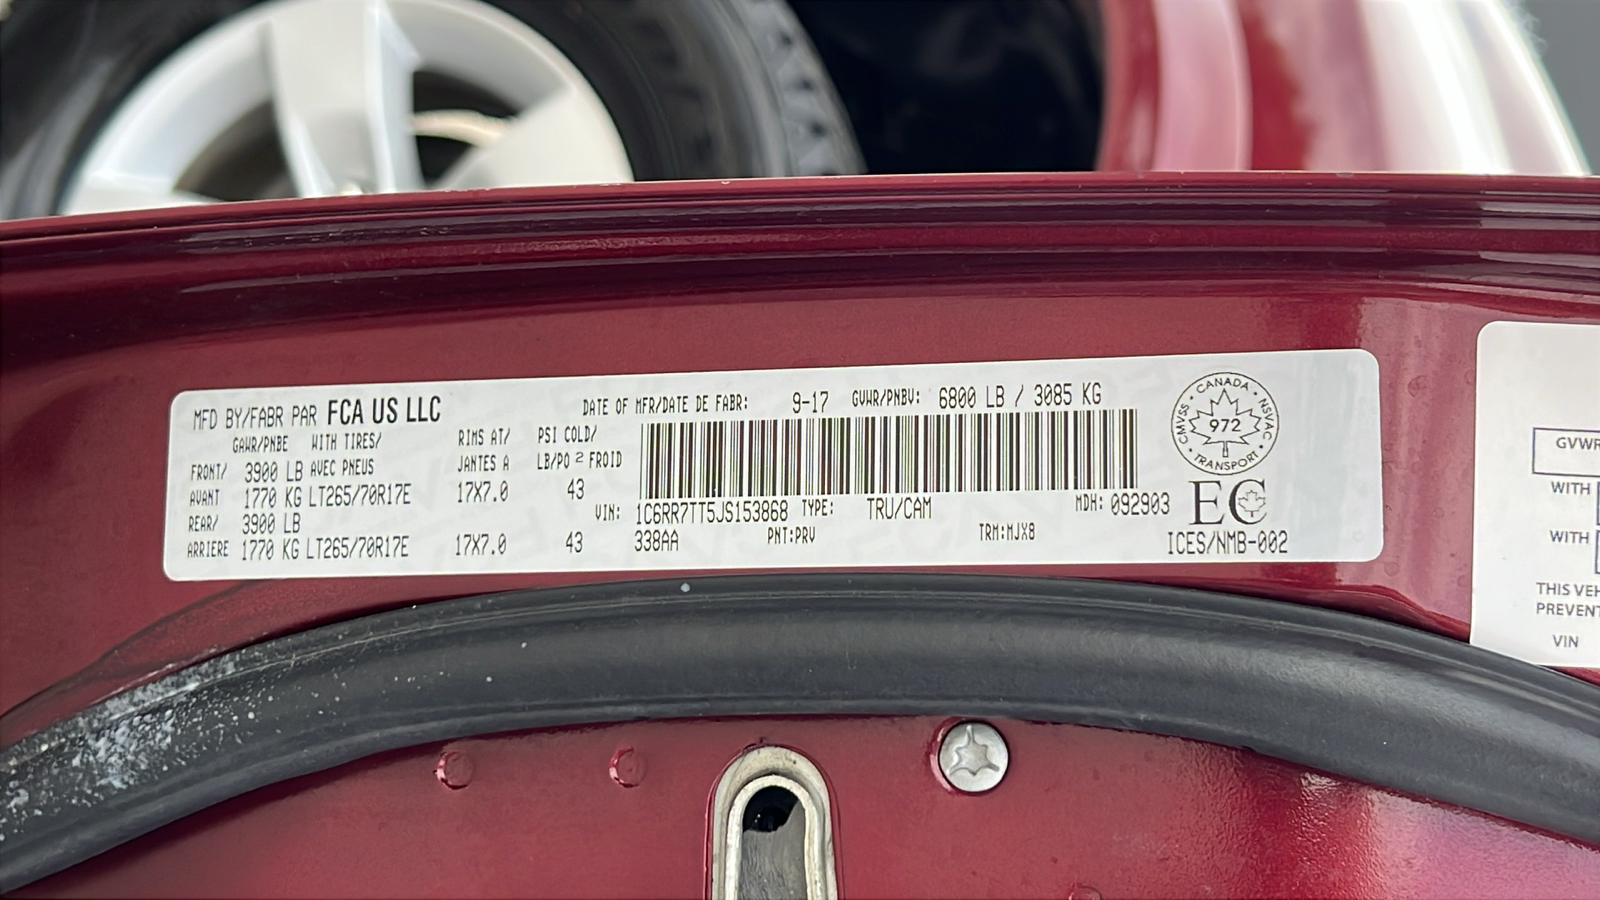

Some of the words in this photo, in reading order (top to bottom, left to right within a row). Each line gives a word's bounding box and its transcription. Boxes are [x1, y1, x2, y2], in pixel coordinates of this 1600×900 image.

[1196, 378, 1248, 394] CANADA
[583, 399, 608, 415] DATE
[616, 398, 628, 414] OF
[635, 396, 688, 414] MFR/DATE
[696, 395, 709, 412] DE
[716, 395, 748, 411] FABR:
[792, 391, 828, 414] 9-17
[852, 388, 920, 407] GVWR/PNBV:
[939, 387, 976, 409] 6800
[986, 385, 1005, 408] LB
[1034, 384, 1072, 406] 3085
[1082, 383, 1101, 405] KG
[194, 409, 218, 430] MFD
[225, 407, 284, 429] BY/FABR
[291, 405, 317, 426] PAR
[327, 400, 363, 425] FCA
[372, 398, 398, 424] US
[407, 396, 441, 422] LLC
[1257, 397, 1274, 441] NSVAC
[1176, 403, 1189, 445] CMVSS
[1209, 419, 1241, 432] 972
[232, 435, 288, 453] GAWR/PNBE
[312, 433, 336, 451] WITH
[345, 432, 382, 449] TIRES/
[458, 429, 484, 446] RIMS
[491, 428, 510, 445] AT/
[538, 426, 557, 444] PSI
[564, 425, 597, 443] COLD/
[1556, 437, 1600, 450] GVWR
[310, 460, 336, 476] AVEC
[342, 459, 374, 475] PNEUS
[458, 455, 496, 472] JANTES
[503, 455, 510, 471] A
[537, 452, 570, 470] LB/PO
[589, 451, 622, 469] FROID
[1193, 450, 1259, 470] TRANSPORT
[191, 463, 227, 481] FRONT/
[244, 462, 277, 483] 3900
[286, 460, 303, 482] LB
[190, 489, 219, 506] AVANT
[244, 487, 276, 509] 1770
[285, 486, 302, 508] KG
[309, 483, 411, 507] LT265/70R17E
[458, 481, 508, 503] 17X7.0
[567, 478, 585, 499] 43
[1551, 482, 1590, 495] WITH
[596, 504, 620, 521] VIN:
[637, 500, 788, 524] 1C6RR7TT5JS153868
[802, 499, 834, 516] TYPE:
[867, 497, 931, 519] TRU/CAM
[1075, 495, 1102, 512] MDH:
[1111, 492, 1170, 515] 092903
[188, 515, 218, 532] REAR/
[242, 513, 275, 534] 3900
[284, 513, 300, 534] LB
[979, 523, 1035, 541] TRM:MJX8
[187, 540, 229, 558] ARRIERE
[242, 539, 274, 560] 1770
[282, 538, 299, 560] KG
[306, 535, 409, 559] LT265/70R17E
[455, 534, 506, 556] 17X7.0
[566, 531, 583, 553] 43
[635, 530, 679, 551] 338AA
[768, 527, 815, 544] PNT:PRV
[1168, 531, 1288, 555] ICES/NMB-002
[1550, 530, 1589, 544] WITH
[1536, 582, 1570, 596] THIS
[1552, 634, 1579, 648] VIN
